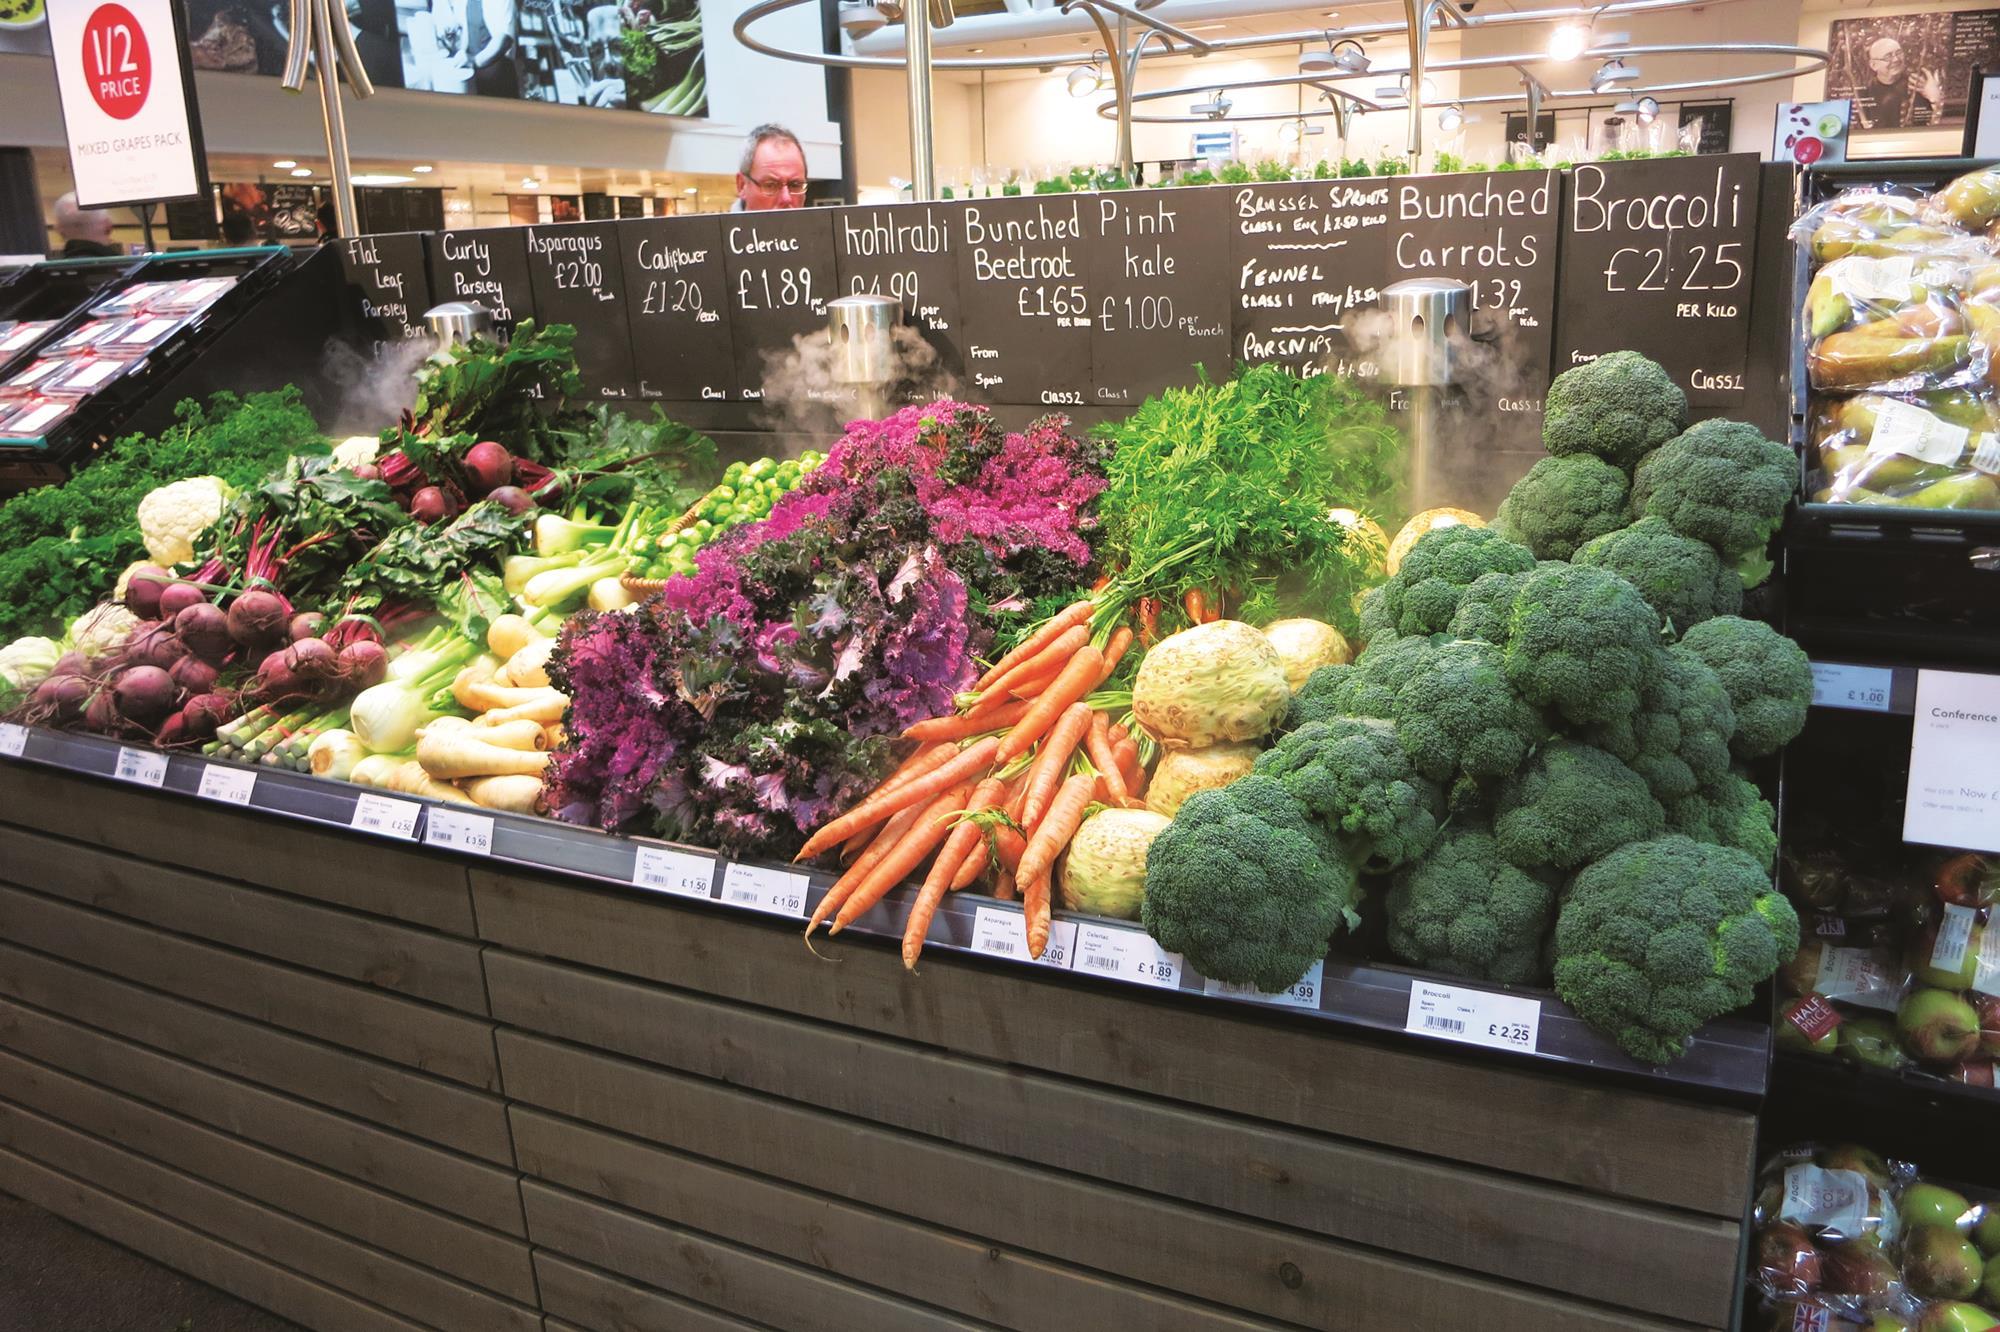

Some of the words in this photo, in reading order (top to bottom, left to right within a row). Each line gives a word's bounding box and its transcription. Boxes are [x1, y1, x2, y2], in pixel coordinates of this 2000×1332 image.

[92, 24, 138, 77] 1/2
[100, 77, 141, 100] PRICE
[77, 140, 110, 156] MIXED
[112, 135, 152, 153] GRAPES
[154, 131, 183, 147] PACK
[1399, 169, 1551, 221] Bunched
[1573, 165, 1741, 233] Broccoli
[965, 200, 1080, 246] Bunched
[1101, 199, 1177, 236] Pink
[349, 238, 382, 265] Flat
[528, 228, 602, 265] Asparagus
[729, 227, 800, 255] Celeriac
[443, 234, 490, 276] Curly
[638, 239, 708, 274] Cauliflower
[974, 247, 1075, 281] Beetroot
[1603, 242, 1742, 292] £2.25
[375, 269, 404, 298] Leaf
[1240, 258, 1324, 289] FENNEL
[455, 272, 503, 304] Parsley
[738, 268, 812, 310] £1.89
[1456, 278, 1522, 310] 1.39
[362, 299, 408, 324] Parsley
[815, 305, 827, 317] kil
[920, 306, 940, 320] per
[1241, 293, 1282, 309] CLASS
[1676, 303, 1702, 318] PER
[1706, 303, 1737, 318] KILO
[403, 323, 427, 338] Bun
[1056, 317, 1072, 328] PER
[1178, 315, 1199, 329] per
[1188, 324, 1224, 337] Bunch
[971, 345, 999, 359] From
[1243, 332, 1332, 361] PARSNIPS
[974, 372, 1003, 388] Spain
[1498, 398, 1531, 412] Class
[1860, 691, 1884, 703] 1.00
[1931, 707, 1998, 723] Conference
[1960, 787, 1987, 799] Now
[397, 822, 412, 832] 2.50
[681, 878, 687, 888] £
[690, 880, 707, 891] 1.50
[772, 895, 778, 905] £
[781, 897, 799, 909] 1.00
[1137, 962, 1146, 973] £
[1150, 964, 1172, 978] 1.89
[1288, 985, 1314, 998] 4.99
[1422, 989, 1451, 999] Broccoli
[1791, 996, 1820, 1025] HALF
[1800, 1005, 1832, 1033] PRICE
[1489, 1024, 1497, 1036] £
[1501, 1026, 1530, 1041] 2.25
